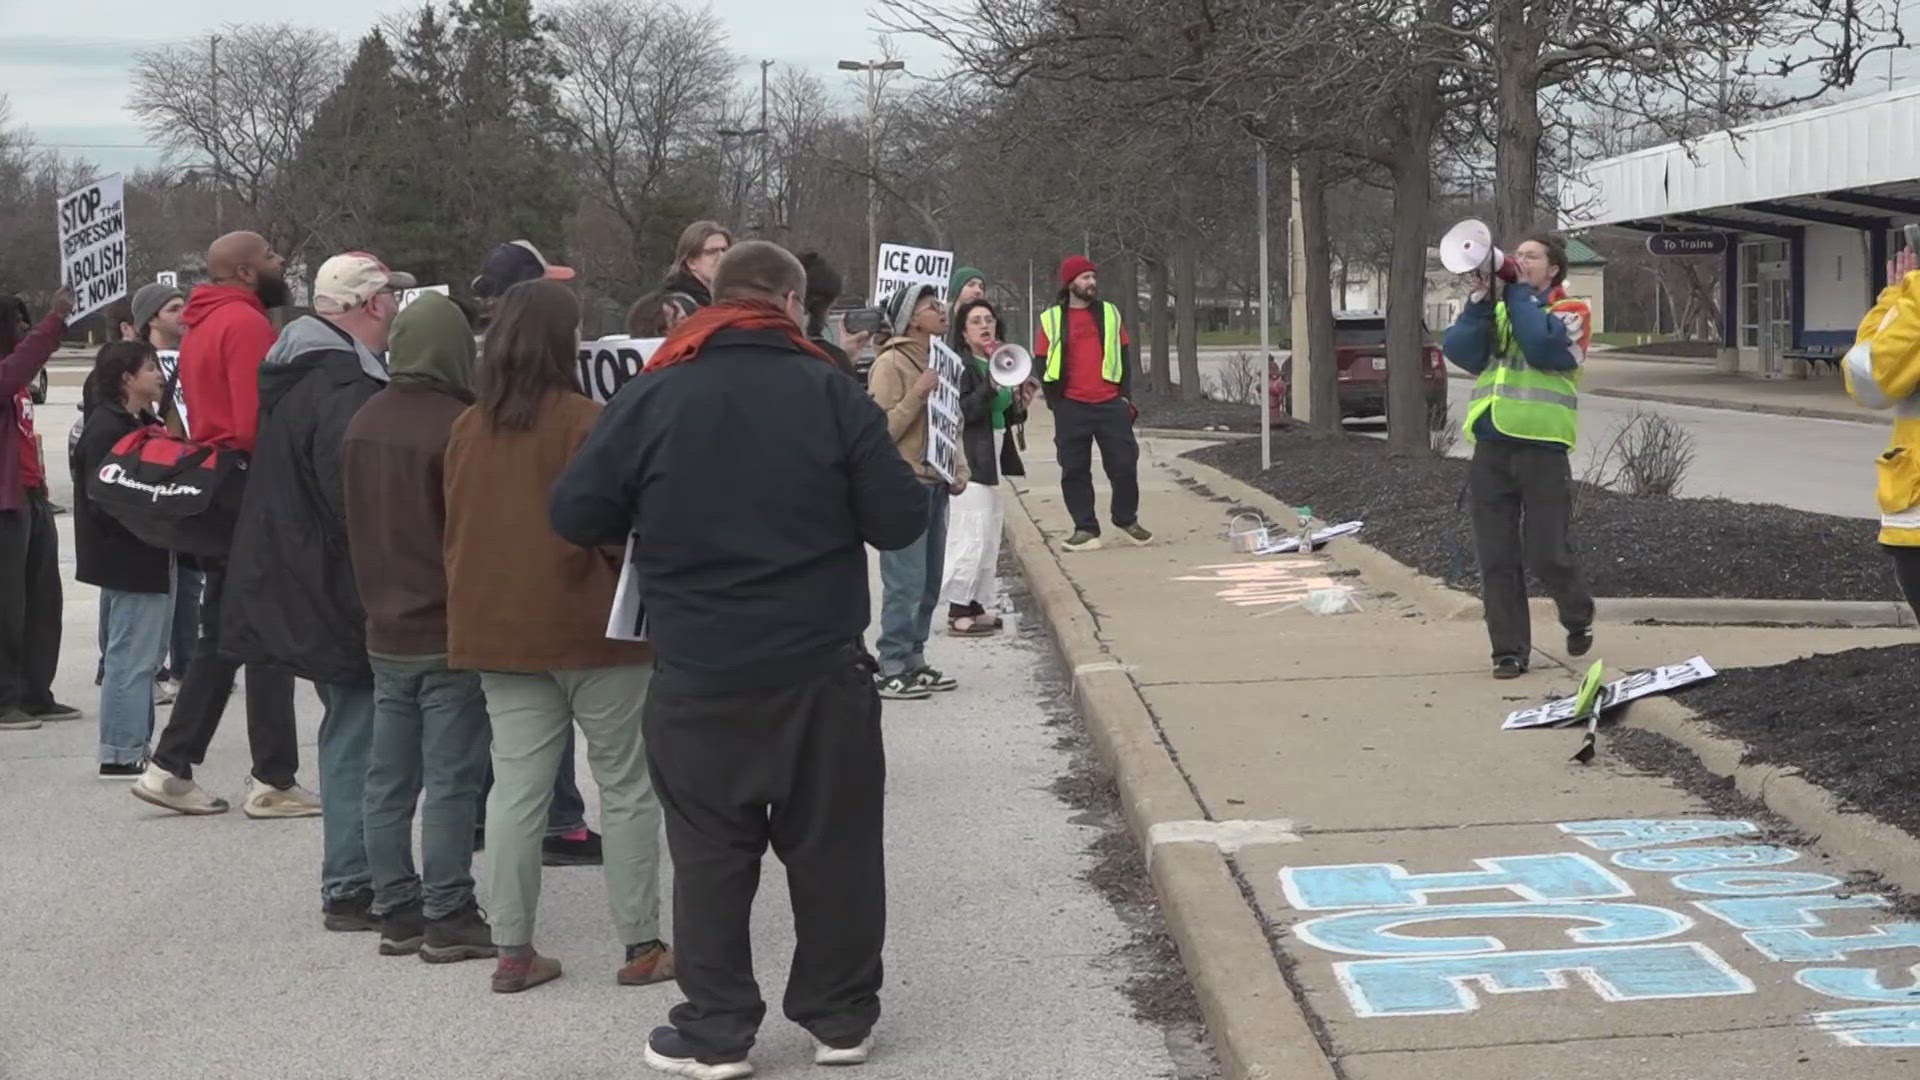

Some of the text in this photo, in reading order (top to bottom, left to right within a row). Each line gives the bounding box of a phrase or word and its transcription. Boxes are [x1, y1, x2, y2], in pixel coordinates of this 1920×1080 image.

[62, 187, 100, 235] STOP
[1663, 239, 1714, 250] To Trains
[66, 240, 123, 289] ABOLISH
[884, 250, 950, 279] ICE OUT!
[89, 269, 124, 306] NOW!
[99, 463, 202, 502] Champion
[1277, 851, 1757, 1018] ICE
